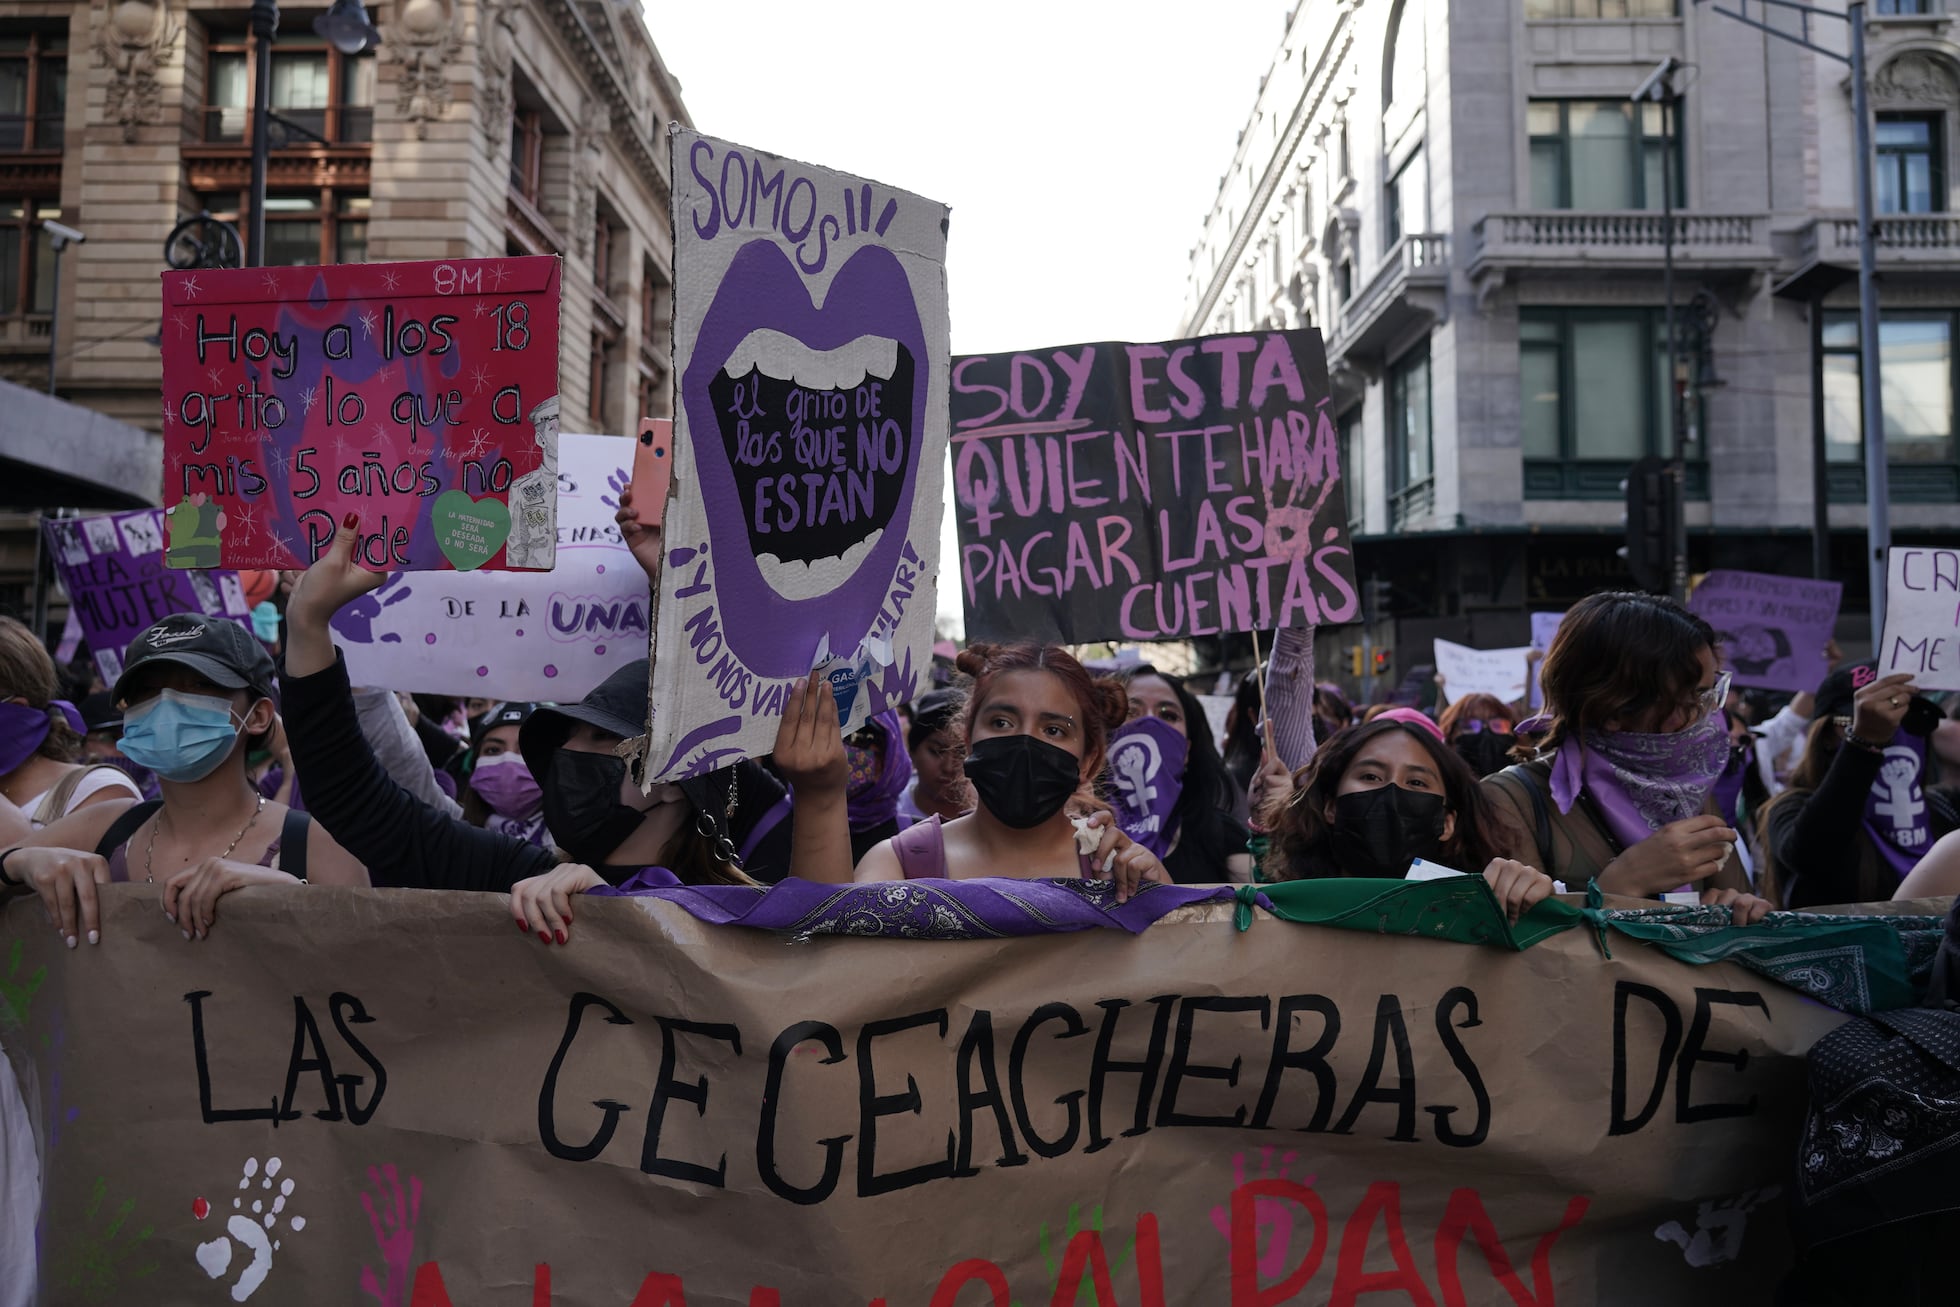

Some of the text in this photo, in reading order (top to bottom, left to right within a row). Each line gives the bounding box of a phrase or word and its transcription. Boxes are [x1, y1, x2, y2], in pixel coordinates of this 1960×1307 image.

[432, 264, 483, 296] 8M
[197, 300, 531, 379] Hoy a los 18
[728, 373, 767, 420] el
[855, 382, 883, 420] DE
[952, 333, 1306, 428] SOY ESTA
[179, 375, 522, 454] grito lo que a
[182, 448, 514, 498] mis 5 años no
[733, 418, 904, 476] las QUE NO
[955, 428, 1152, 536] QUIEN
[451, 529, 486, 545] DESEADA
[458, 514, 495, 529] MATERNIDAD
[963, 495, 1266, 608] PAGAR LAS
[444, 597, 475, 618] DE
[499, 598, 531, 618] LA
[1891, 636, 1946, 673] ME
[183, 989, 388, 1129] LAS
[1607, 980, 1776, 1137] DE
